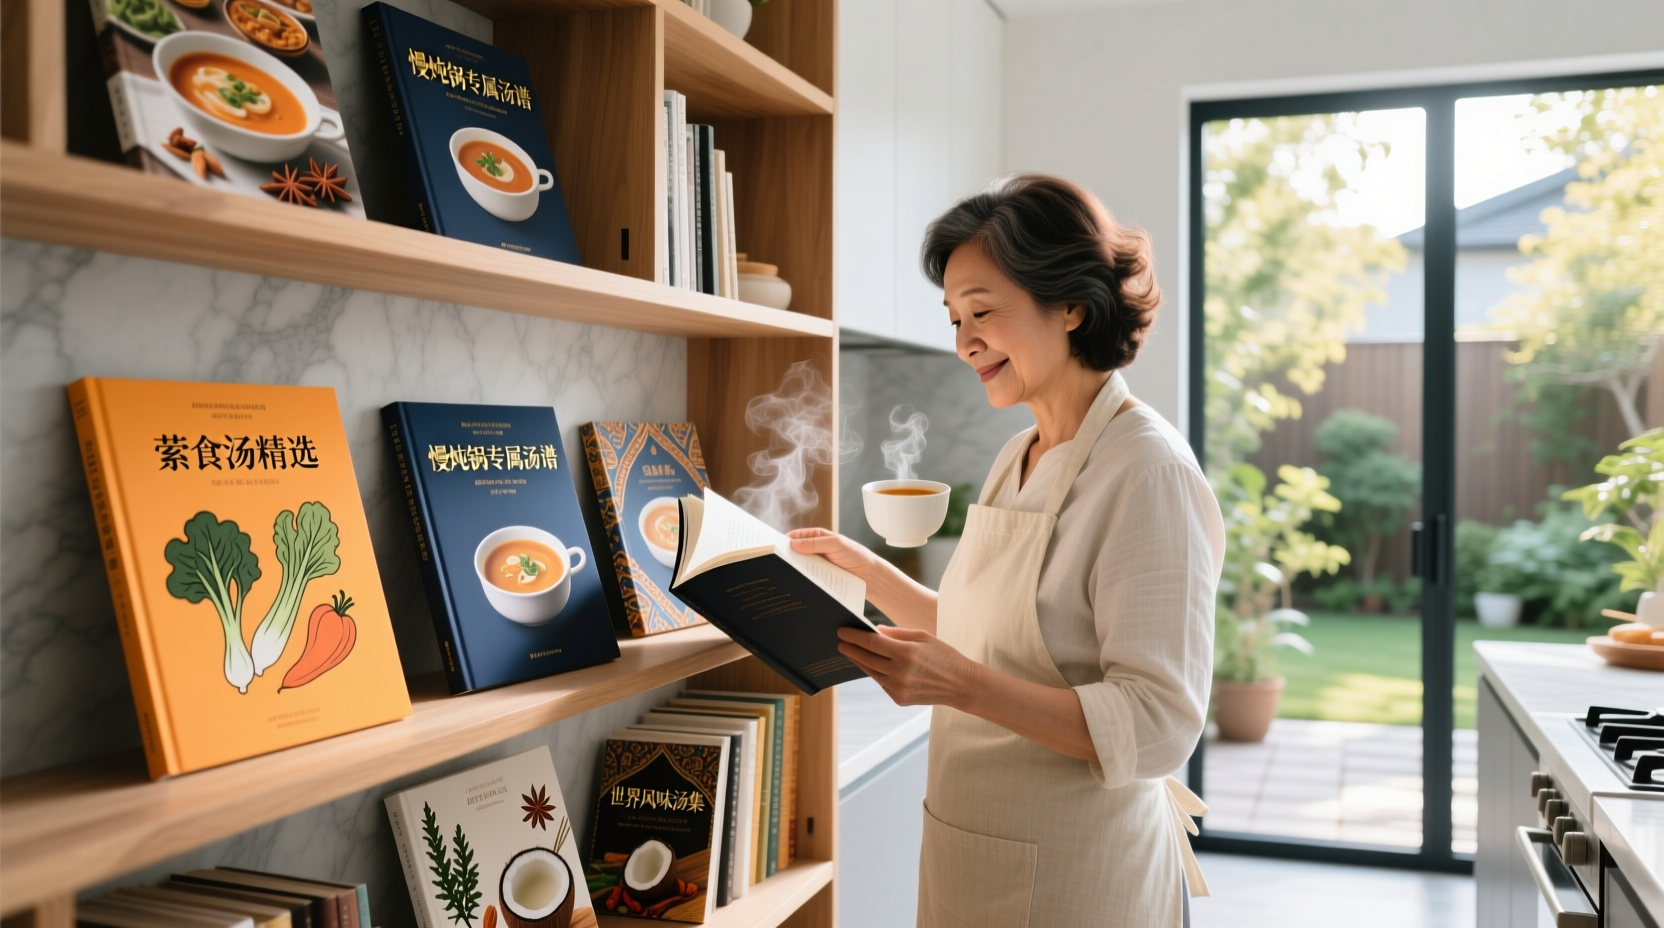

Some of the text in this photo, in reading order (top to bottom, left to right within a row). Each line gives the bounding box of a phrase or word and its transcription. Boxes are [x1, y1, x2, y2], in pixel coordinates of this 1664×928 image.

[428, 444, 558, 472] 慢炖锅专属汤谱
[610, 785, 705, 814] 世界风味汤集
